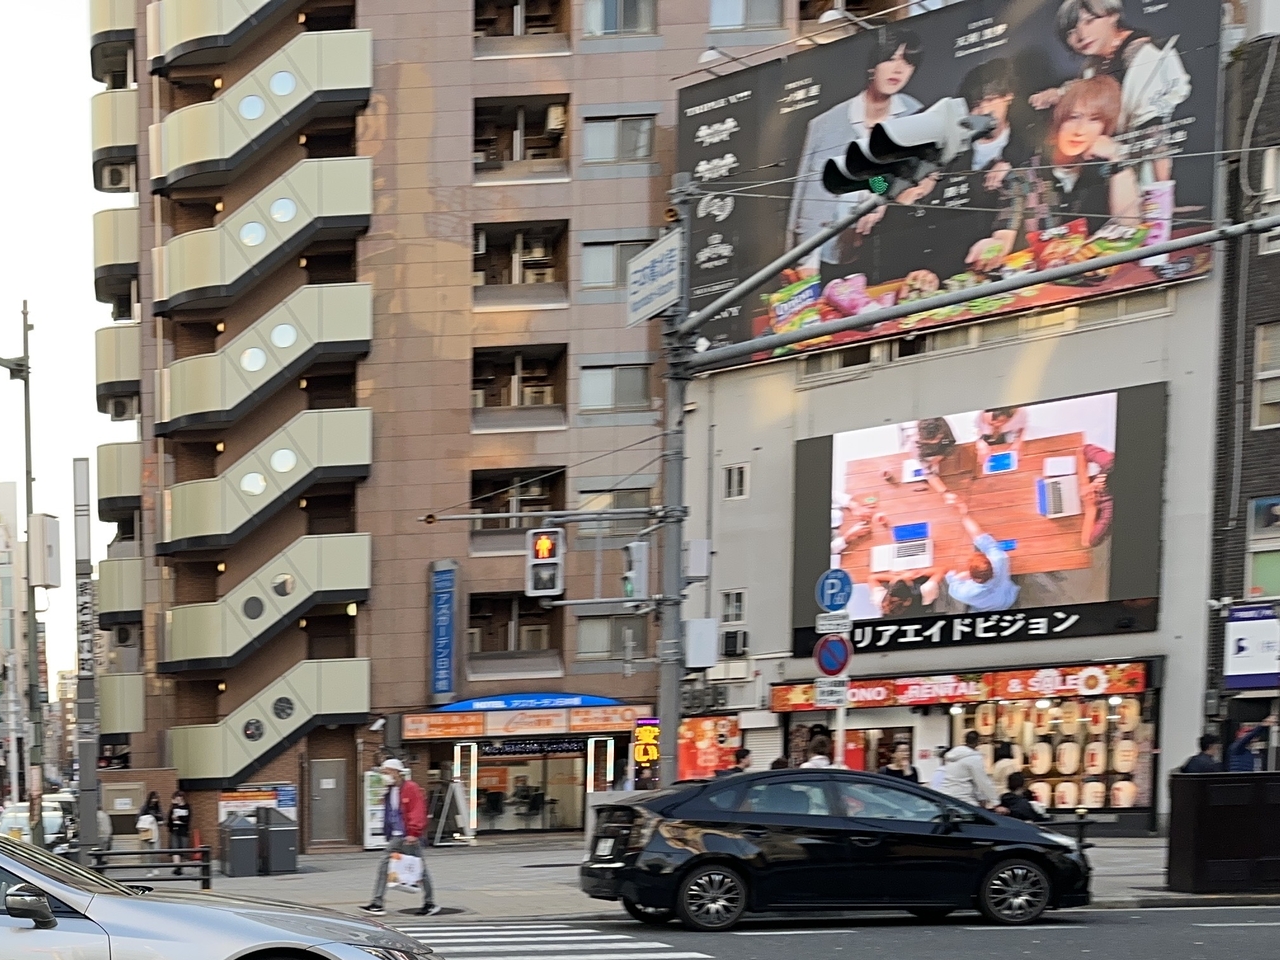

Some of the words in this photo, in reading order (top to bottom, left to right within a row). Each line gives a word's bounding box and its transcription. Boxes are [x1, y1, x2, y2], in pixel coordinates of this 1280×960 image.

[853, 611, 1081, 648] リアエイドビジョン
[906, 681, 981, 699] RENTAL
[1027, 674, 1080, 691] SALE
